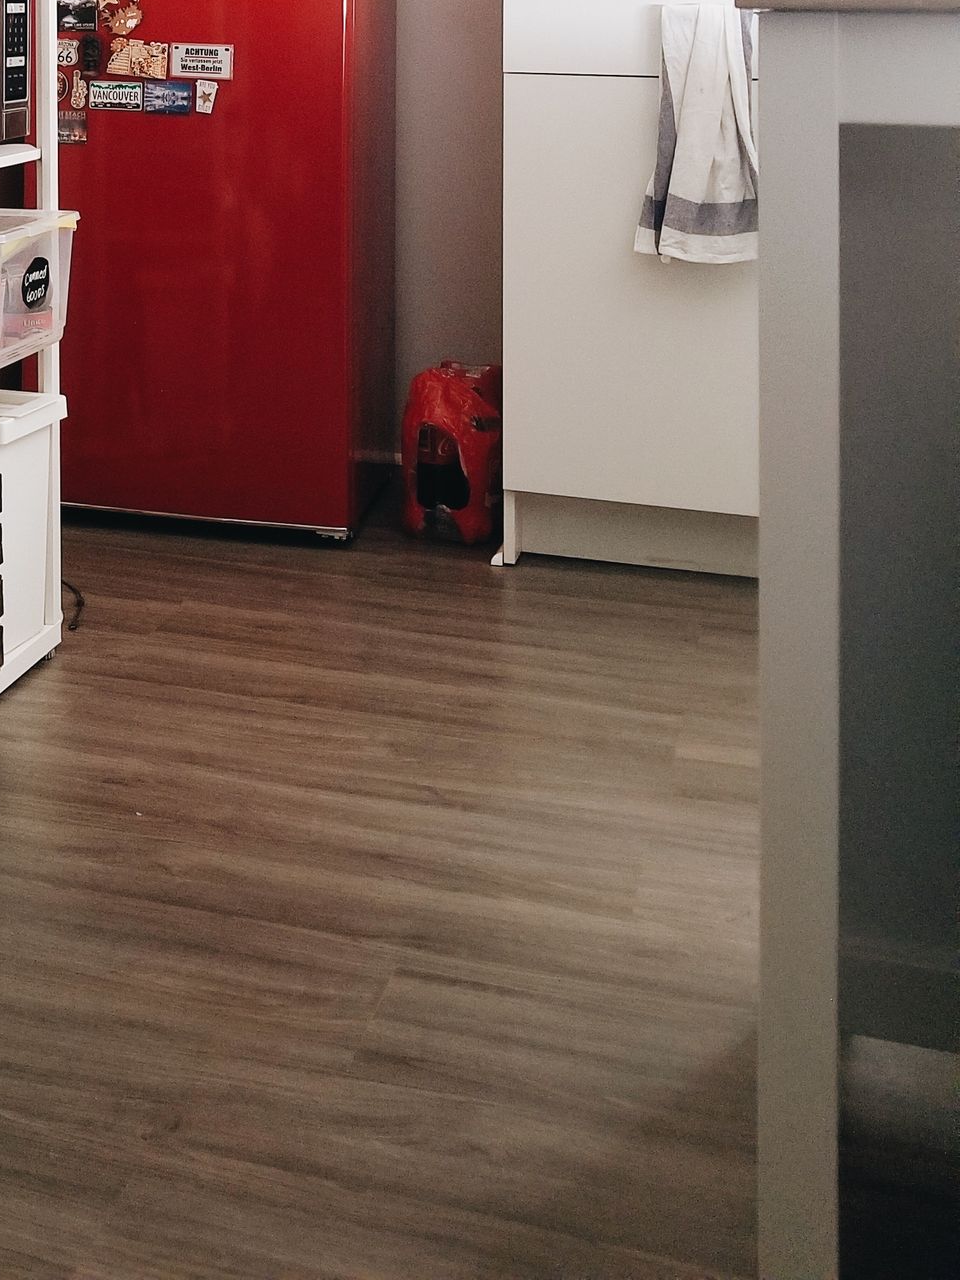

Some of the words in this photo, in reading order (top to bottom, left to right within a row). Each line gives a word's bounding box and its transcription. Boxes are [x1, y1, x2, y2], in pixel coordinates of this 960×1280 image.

[57, 50, 73, 64] 66
[185, 47, 219, 57] ACHTUNG
[180, 63, 223, 72] West-Berlin
[92, 89, 139, 102] VANCOUVER
